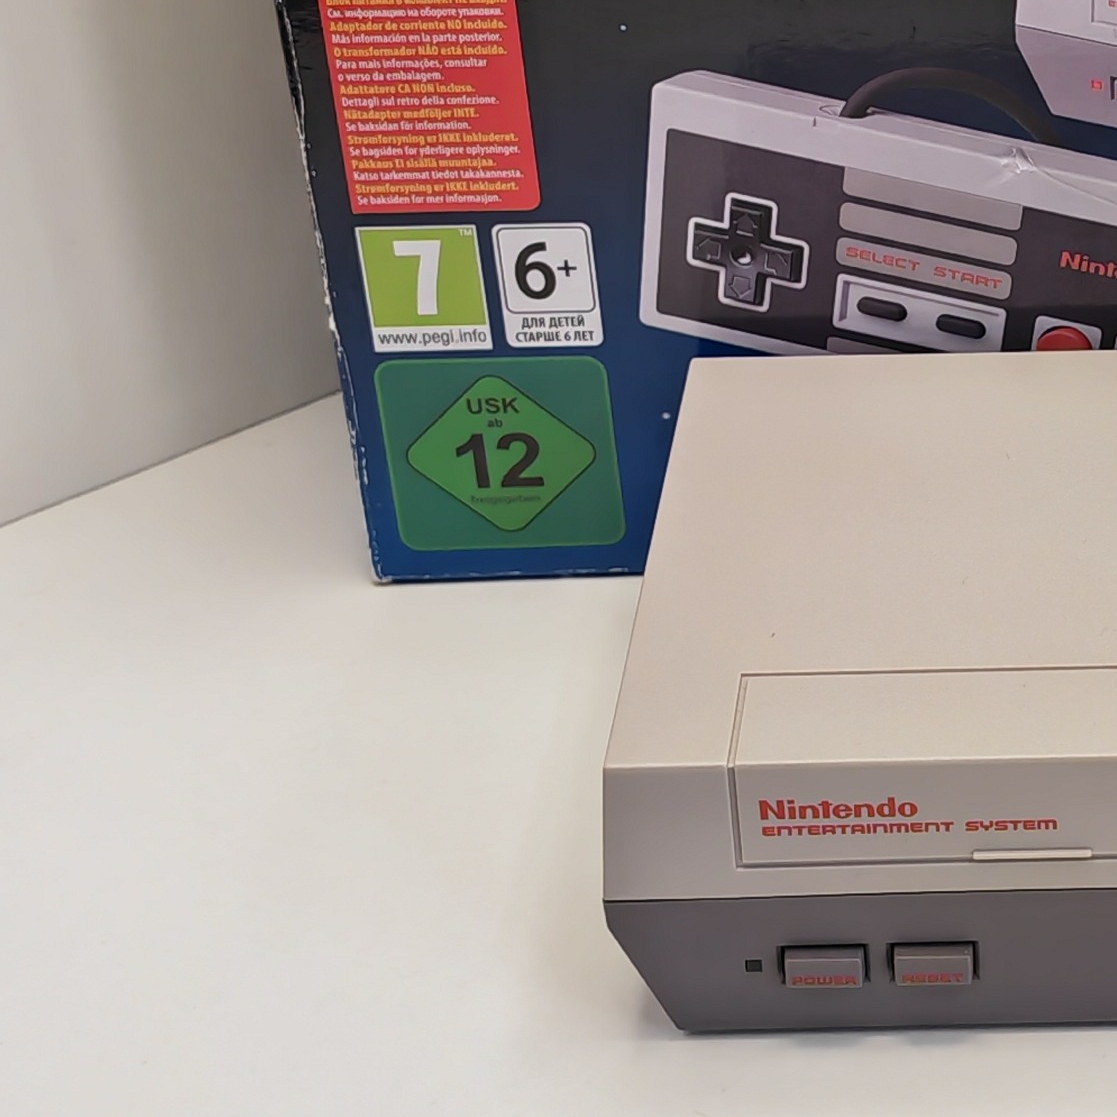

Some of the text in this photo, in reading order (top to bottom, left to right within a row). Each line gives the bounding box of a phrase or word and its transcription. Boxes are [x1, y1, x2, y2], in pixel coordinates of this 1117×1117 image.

[332, 33, 502, 45] Más información en la parte posterior.
[336, 58, 487, 71] Para mais informações, consultar
[338, 72, 445, 84] o verso da embalagem.
[342, 95, 499, 109] Dettagli sul retro della confezione.
[346, 121, 472, 133] Se baksidan för information.
[514, 241, 577, 300] 6+
[845, 246, 1003, 289] SELECT START
[392, 239, 441, 316] 7
[521, 315, 585, 329] ДЛЯ ДЕТЕЙ
[378, 328, 487, 346] www.pegi.info
[515, 330, 595, 343] СТАРШЕ 6 ЛЕТ
[466, 397, 520, 414] USK
[487, 418, 503, 428] ab
[456, 432, 545, 489] 12
[757, 796, 918, 821] Nintendo
[762, 819, 1058, 836] ENTERTAINMENT SYSTEM
[792, 975, 857, 985] POWER
